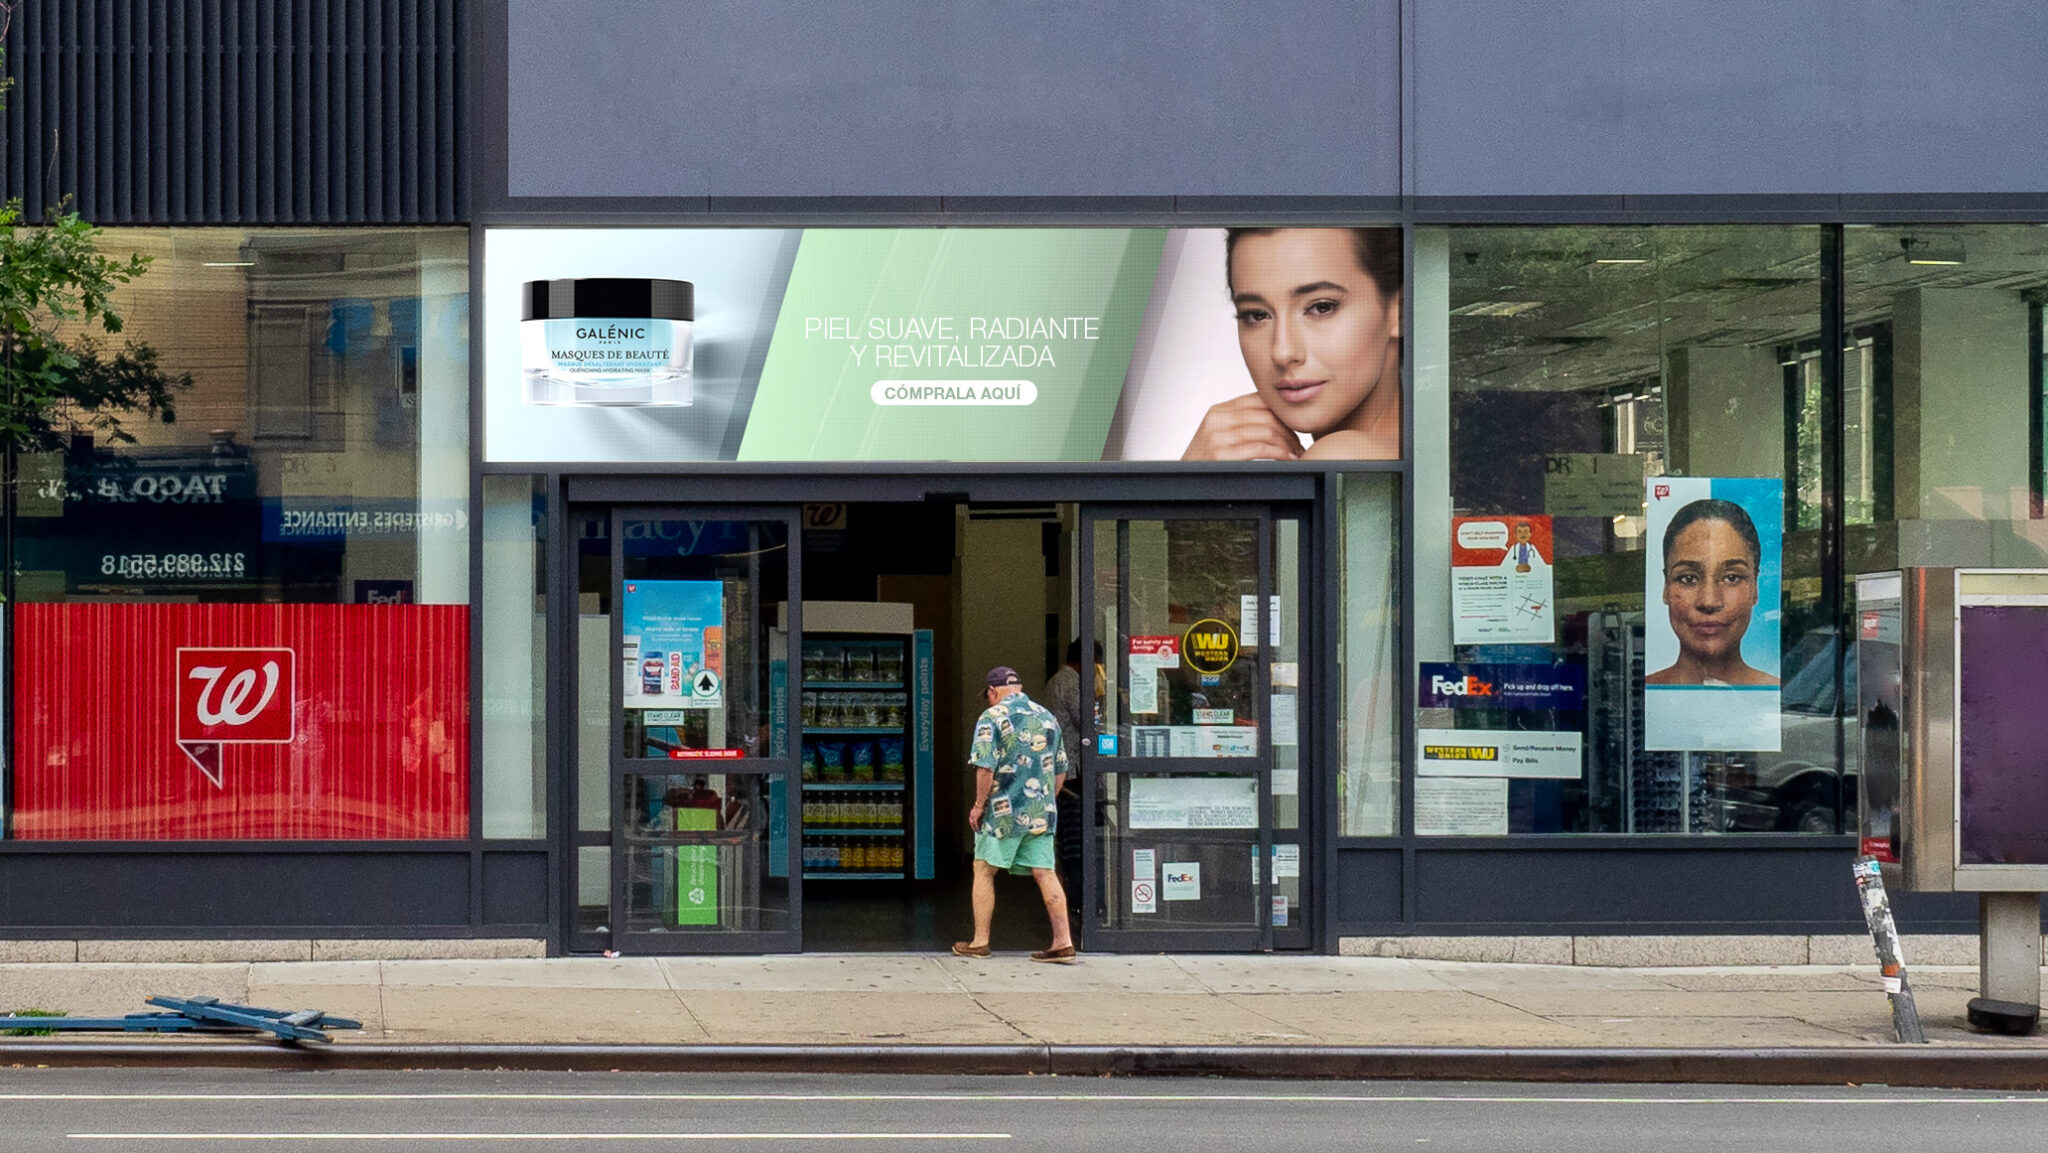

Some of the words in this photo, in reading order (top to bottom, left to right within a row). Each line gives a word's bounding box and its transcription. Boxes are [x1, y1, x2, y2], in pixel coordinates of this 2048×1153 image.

[576, 324, 646, 339] GALÉNIC
[805, 317, 860, 340] PIEL
[868, 317, 959, 343] SUAVE,
[970, 317, 1100, 340] RADIANTE
[551, 350, 604, 362] MASQUES
[607, 350, 622, 360] DE
[625, 348, 670, 360] BEAUTÉ
[851, 345, 867, 367] Y
[876, 345, 1056, 367] REVITALIZADA
[885, 383, 977, 400] CÓMPRALA
[981, 383, 1021, 402] AQUÍ
[919, 657, 929, 695] points
[1432, 675, 1493, 696] FedEx
[188, 661, 279, 726] W
[773, 687, 784, 724] points
[919, 697, 929, 752] Everyday
[1168, 873, 1194, 883] FedEx
